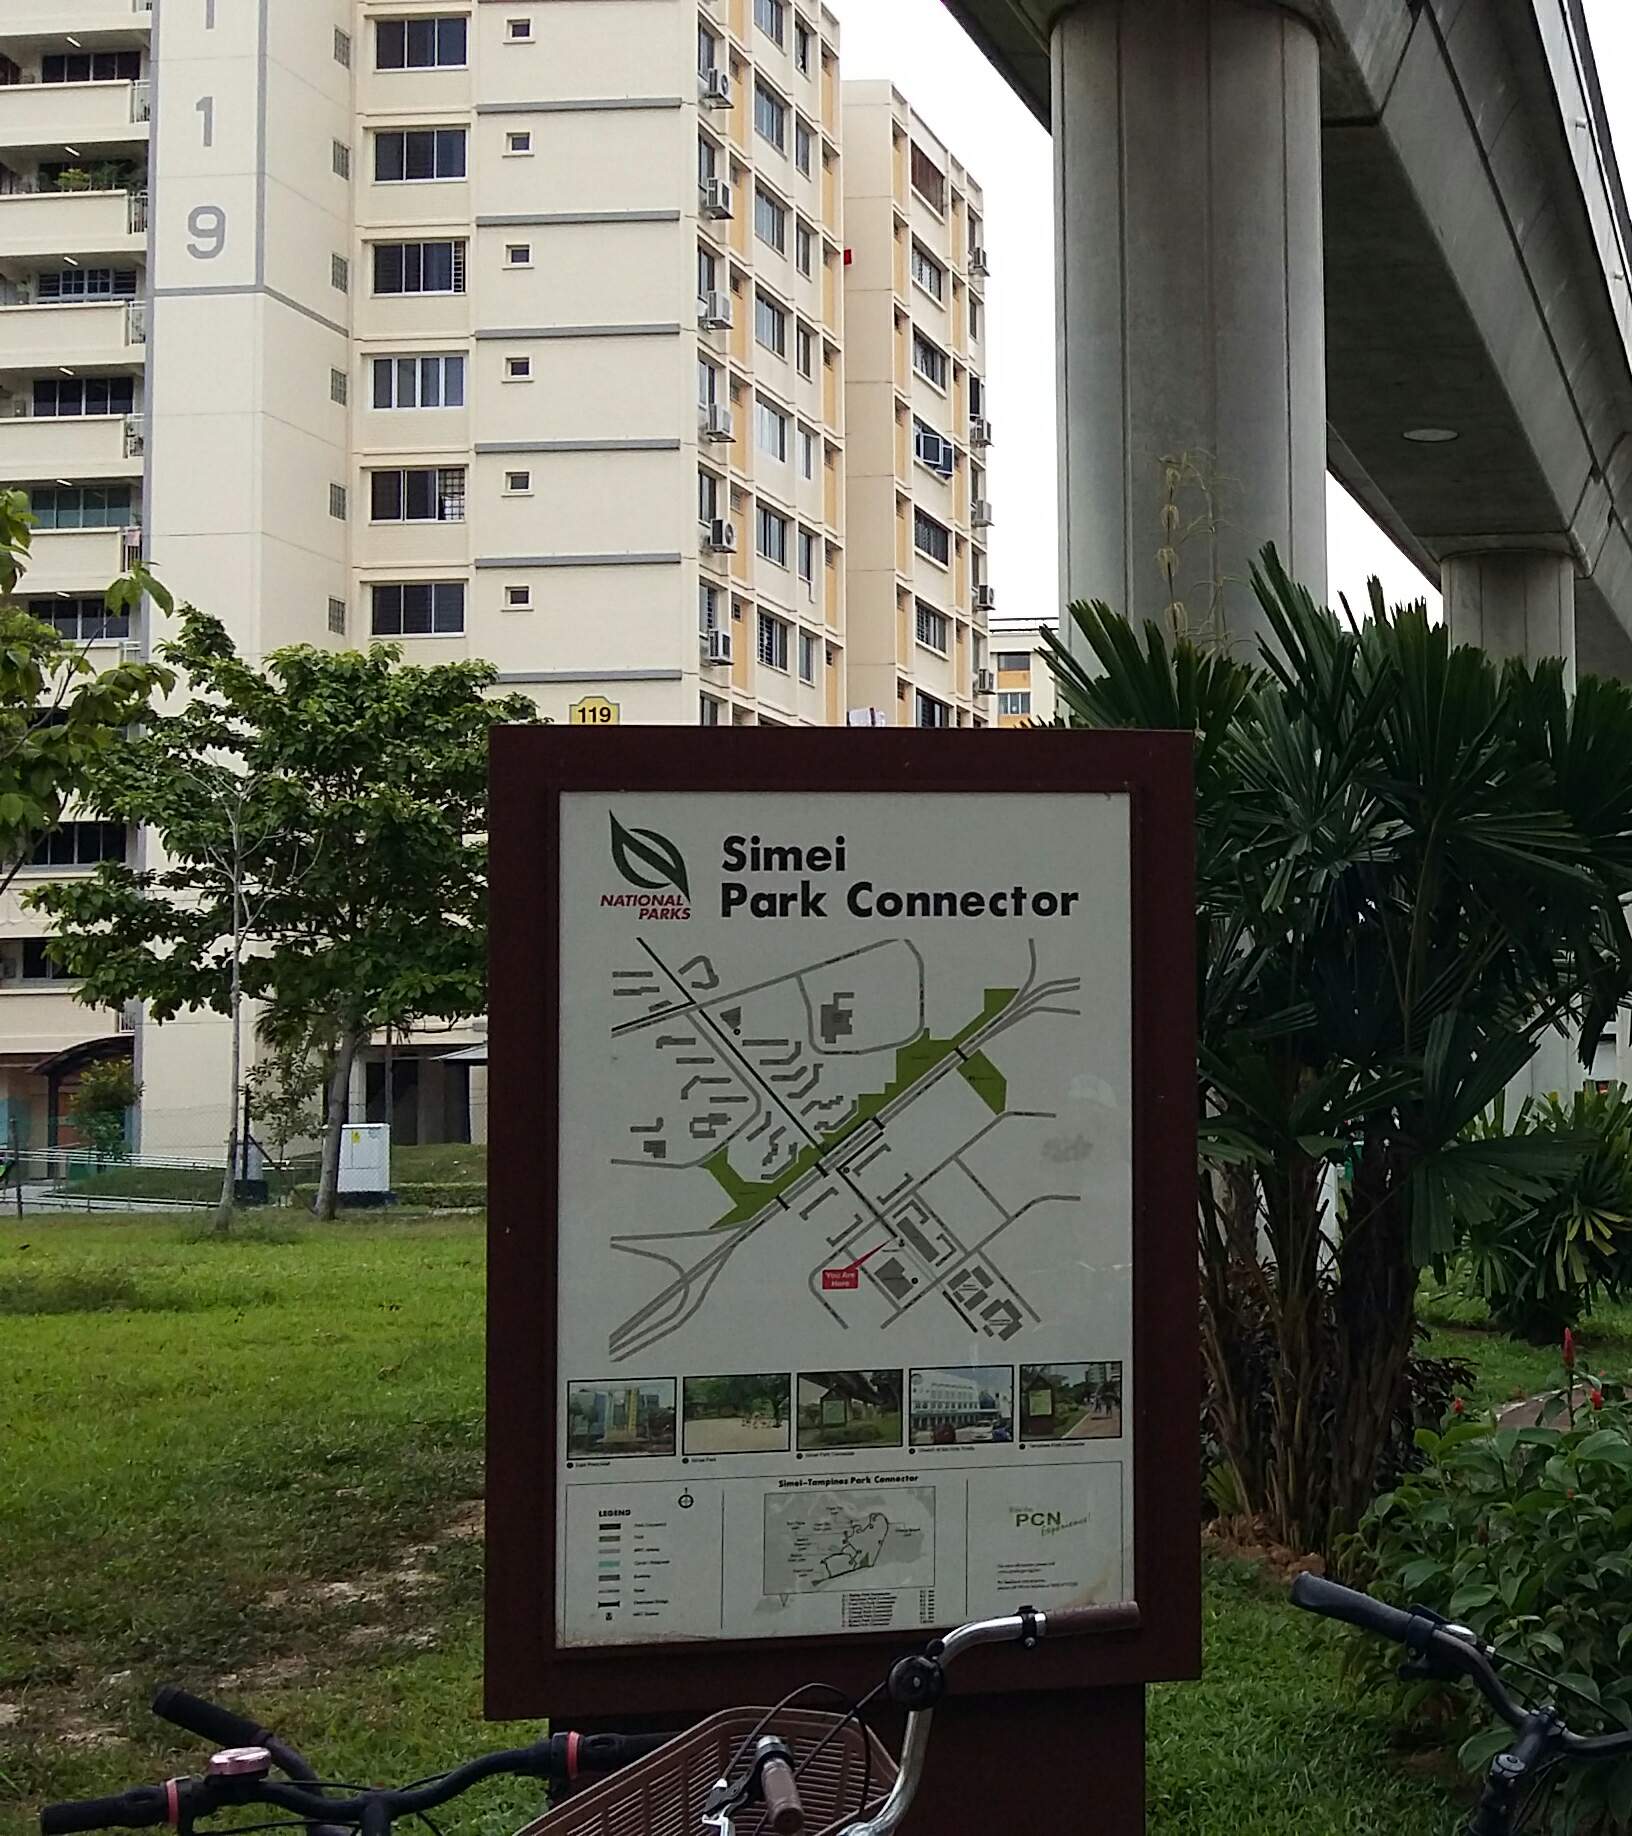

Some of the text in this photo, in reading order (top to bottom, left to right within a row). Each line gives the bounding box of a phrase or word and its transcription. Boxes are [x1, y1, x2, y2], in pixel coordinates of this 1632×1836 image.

[577, 706, 612, 723] 119
[721, 835, 846, 872] Simei
[600, 894, 685, 906] NATIONAL
[720, 879, 1079, 918] Park Connector
[638, 907, 691, 920] PARKS
[778, 1473, 919, 1488] Simei-Tampines Park Connector
[598, 1509, 631, 1518] LEGEND
[1015, 1511, 1062, 1528] PCN
